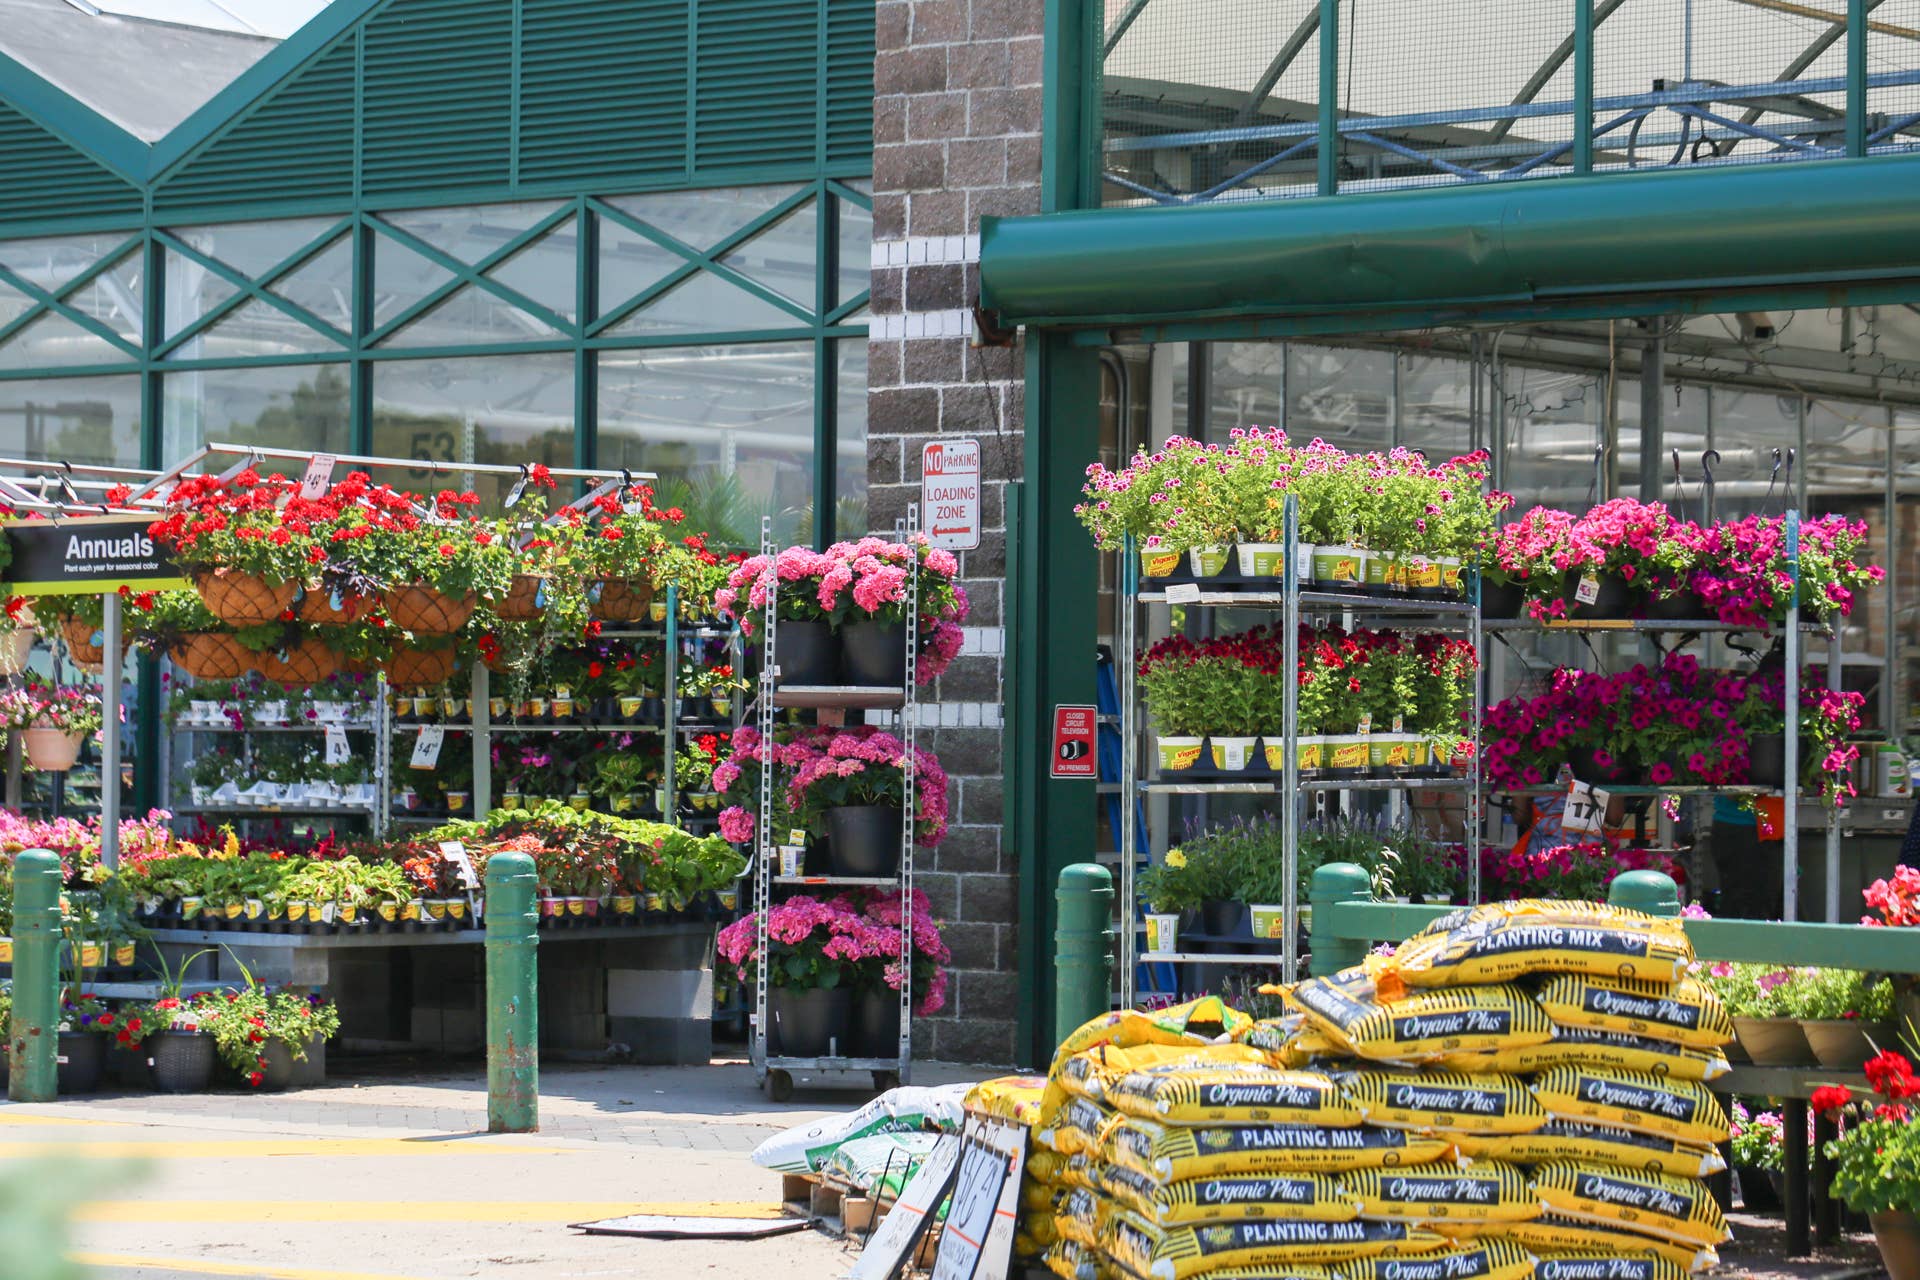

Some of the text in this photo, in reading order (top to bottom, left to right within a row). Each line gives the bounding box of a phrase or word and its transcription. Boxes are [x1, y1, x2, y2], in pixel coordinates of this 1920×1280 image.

[926, 452, 977, 472] NO PARKING
[927, 486, 976, 502] LOADING
[936, 506, 966, 519] ZONE
[65, 533, 154, 560] Annuals
[64, 561, 159, 574] Plant each year for seasonal color
[1065, 712, 1085, 720] CLOSED
[1061, 727, 1089, 735] TELEVISION
[1477, 929, 1602, 952] PLANTING MIX
[1593, 990, 1692, 1024] Organic Plus
[1404, 1010, 1501, 1039] Organic Plus
[1209, 1083, 1312, 1107] Organic Plus
[1396, 1085, 1497, 1113] Organic Plus
[1588, 1080, 1687, 1117] Organic Plus
[1242, 1129, 1326, 1147] PLANTING
[1332, 1129, 1364, 1147] MIX
[1205, 1179, 1306, 1204] Organic Plus
[1389, 1178, 1490, 1202] Organic Plus
[1584, 1177, 1684, 1214] Organic Plus
[1243, 1223, 1327, 1242] PLANTING
[1333, 1223, 1365, 1240] MIX
[1543, 1258, 1646, 1280] Organic Plus
